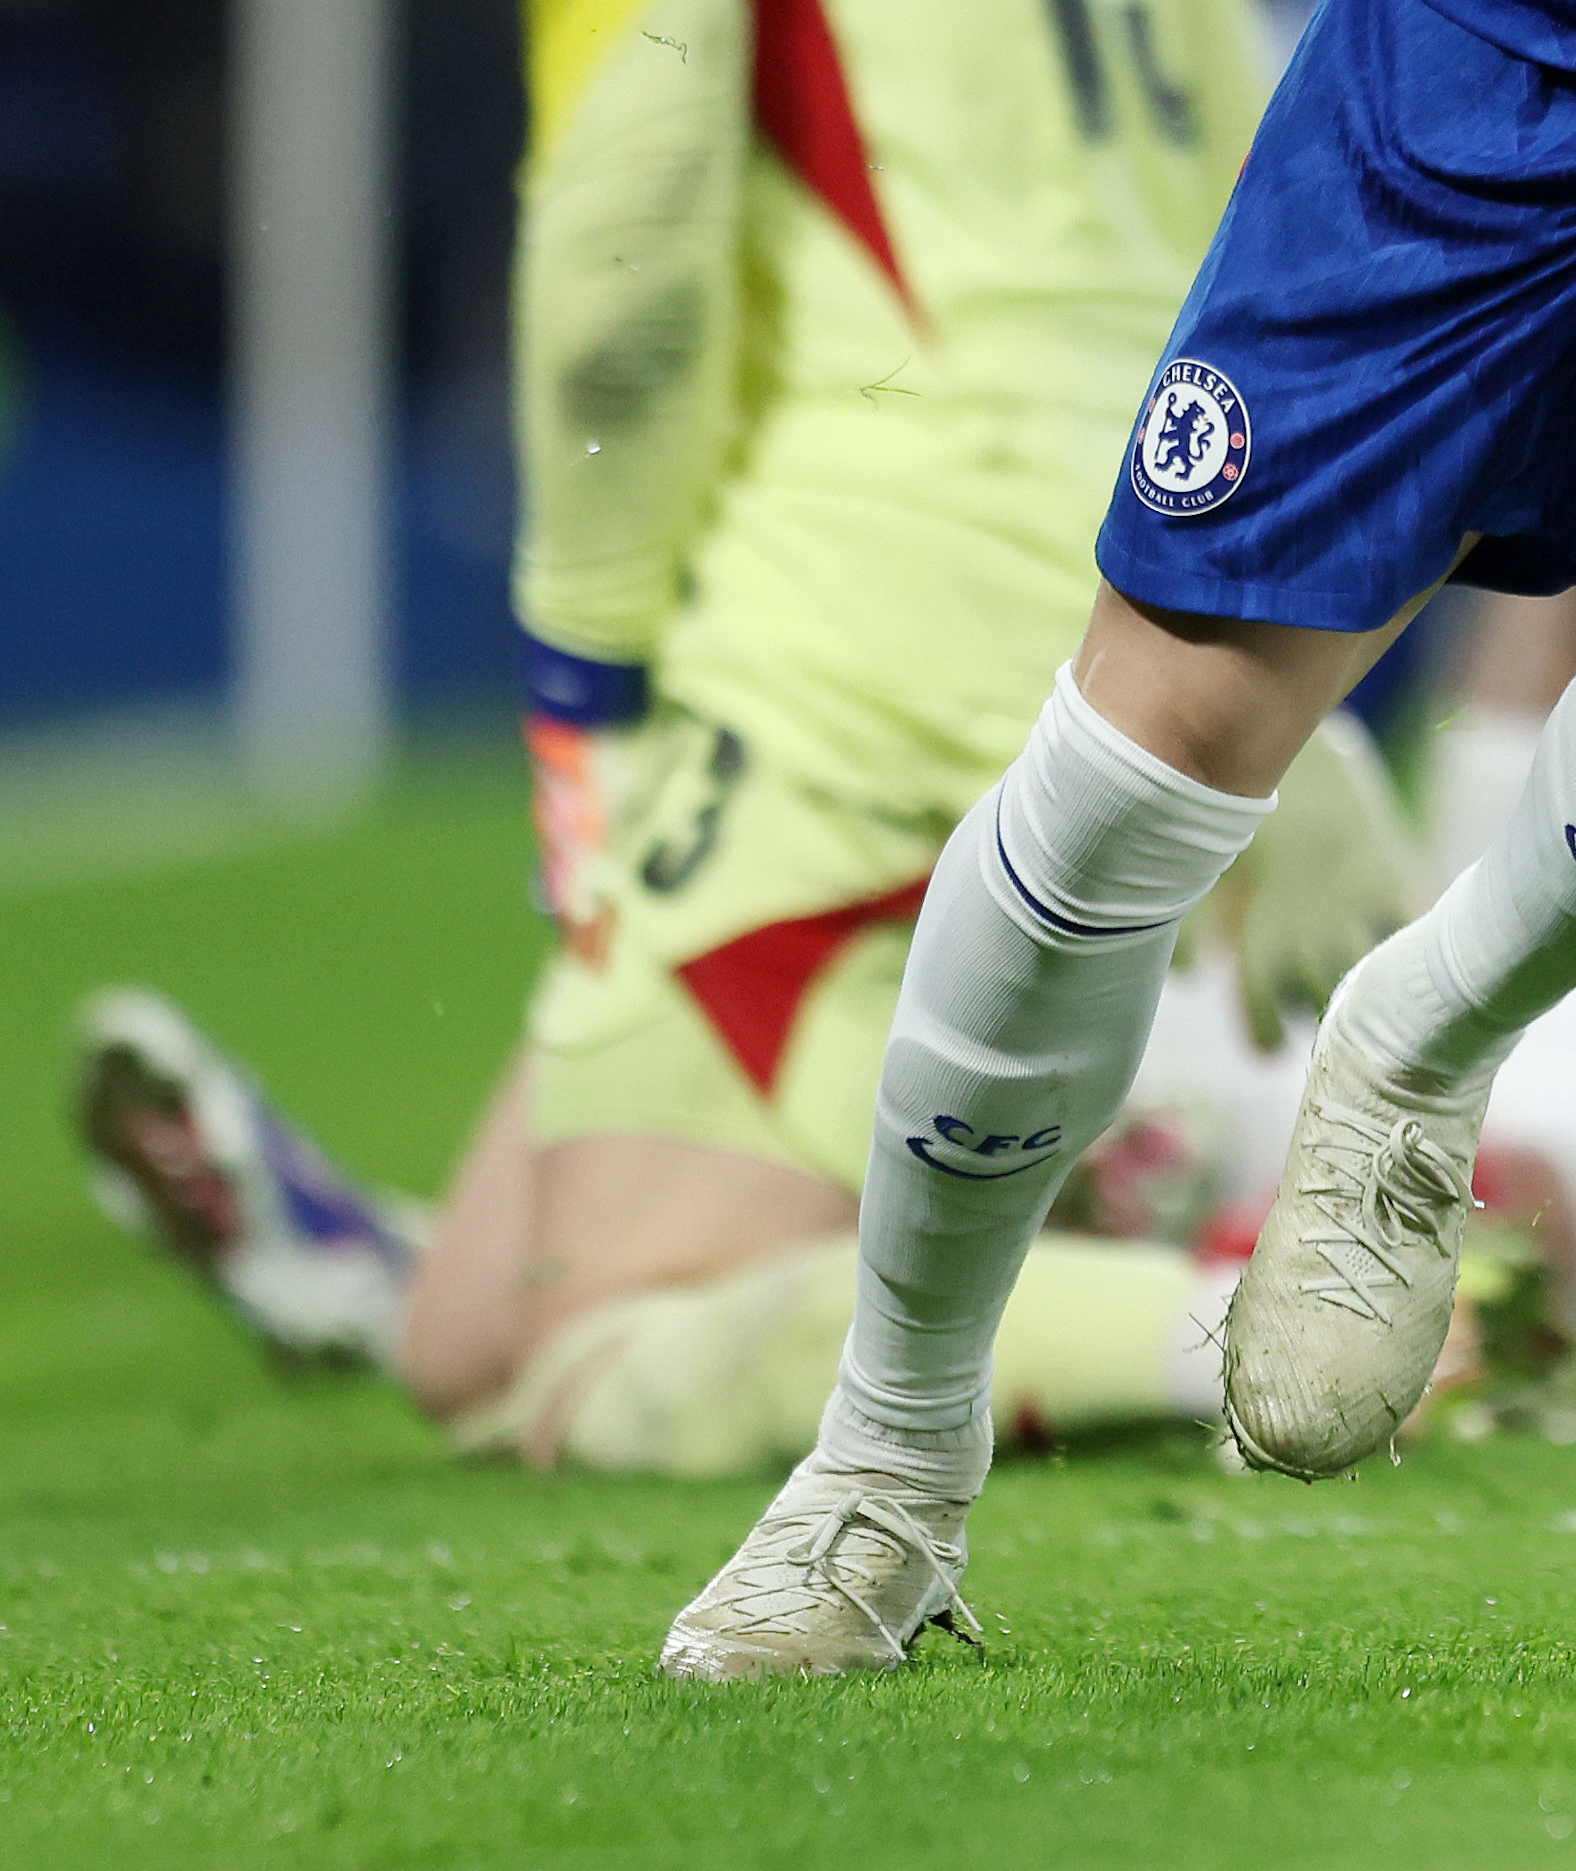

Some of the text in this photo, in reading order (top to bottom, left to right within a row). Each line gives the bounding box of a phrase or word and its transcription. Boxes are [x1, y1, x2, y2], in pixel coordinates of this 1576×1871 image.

[1162, 364, 1237, 413] CHELSEA
[1135, 465, 1214, 508] FOOTBALL CLUB
[932, 1114, 1062, 1157] CFC
